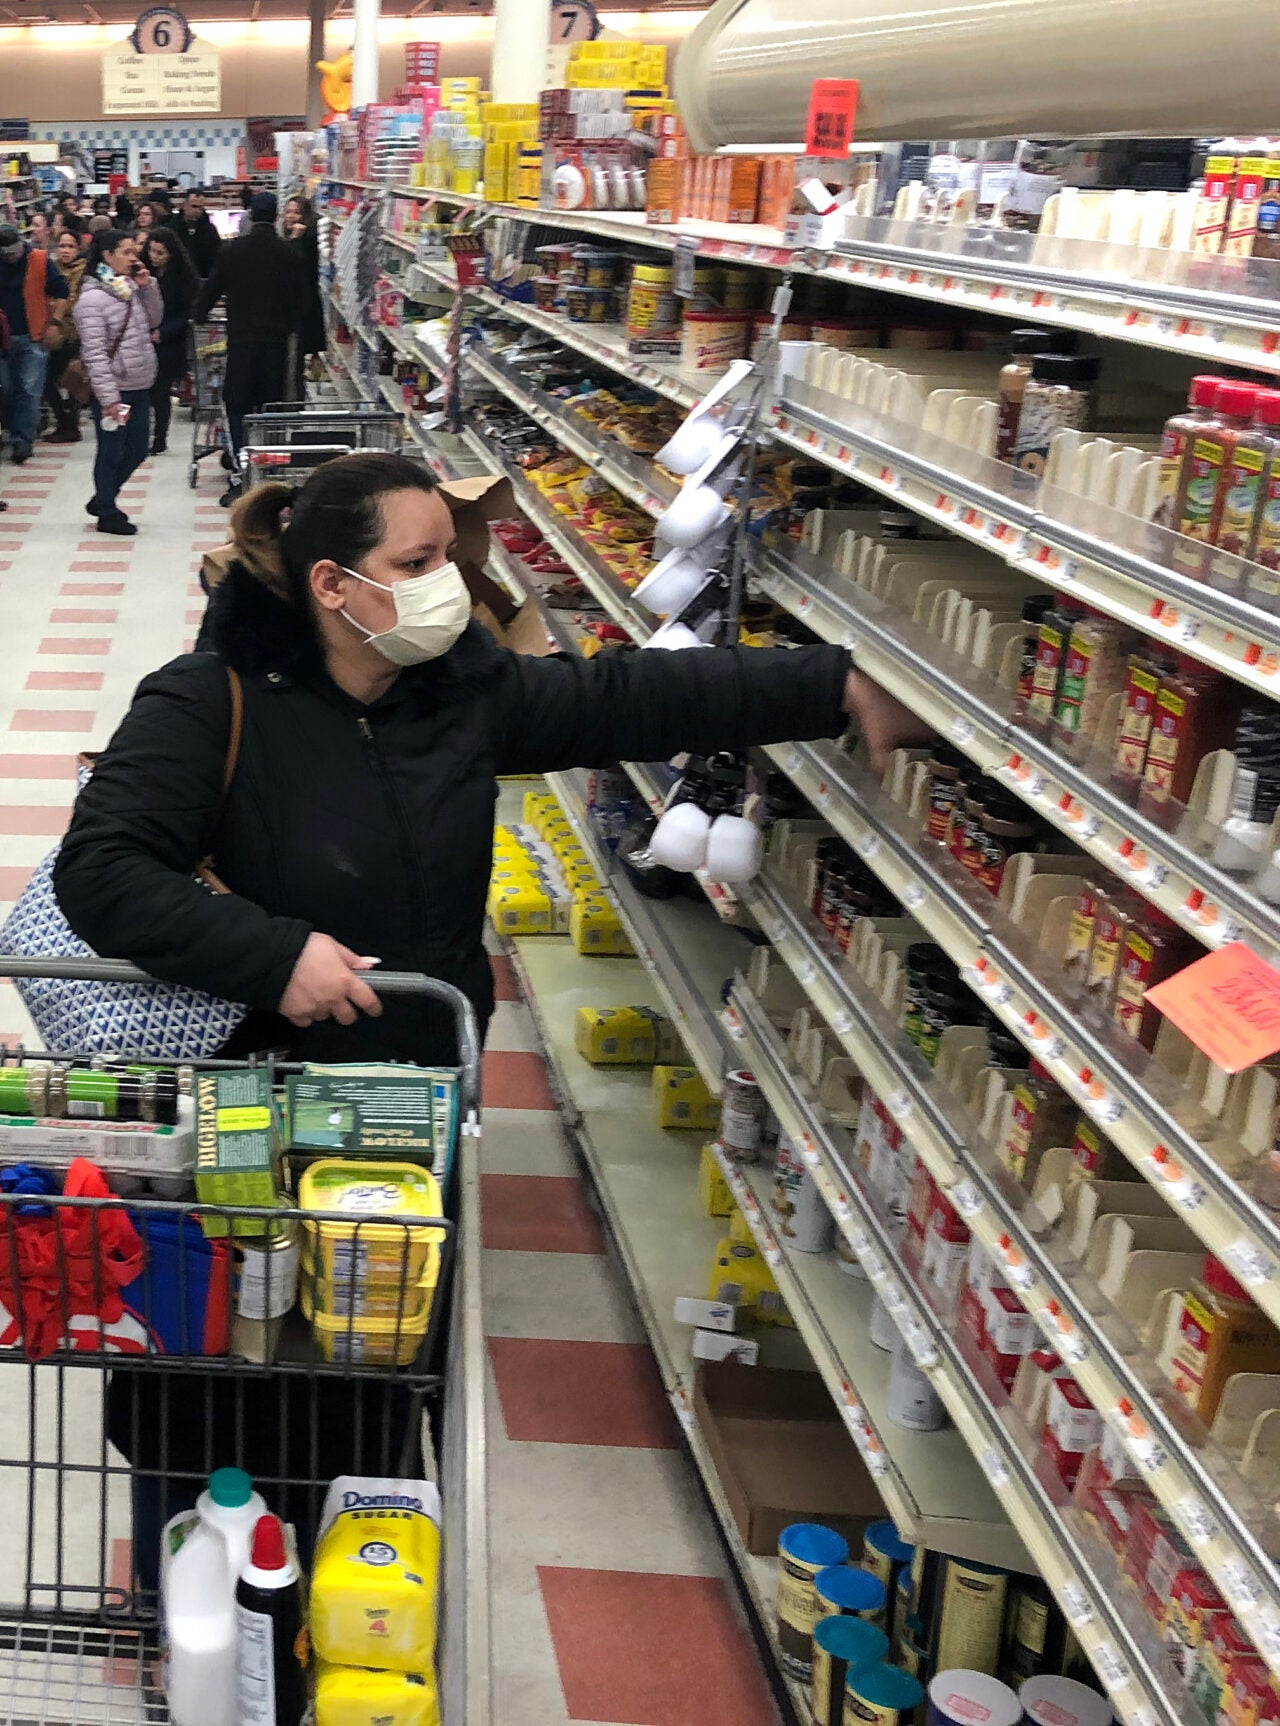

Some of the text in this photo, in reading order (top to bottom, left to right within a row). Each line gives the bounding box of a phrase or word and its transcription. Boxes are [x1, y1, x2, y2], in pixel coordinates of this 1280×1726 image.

[153, 20, 171, 47] 6
[560, 11, 578, 38] 7
[197, 1076, 218, 1168] BIGELOW
[343, 1490, 423, 1509] Domino
[351, 1511, 412, 1520] SUGAR
